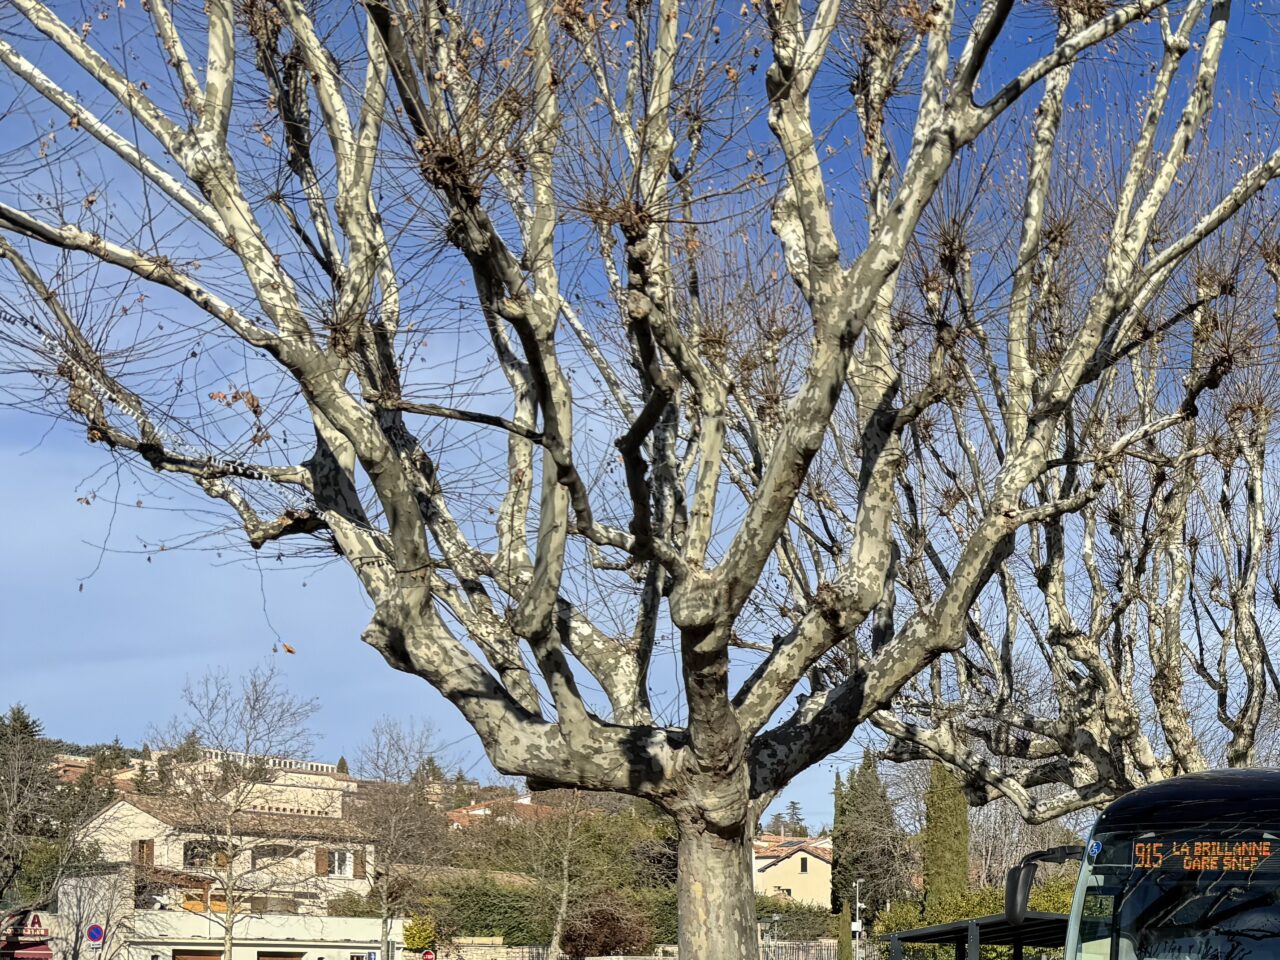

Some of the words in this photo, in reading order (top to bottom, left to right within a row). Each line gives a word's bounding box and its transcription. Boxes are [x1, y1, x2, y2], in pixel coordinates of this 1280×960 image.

[1135, 843, 1163, 868] 915
[1172, 841, 1190, 856] LA
[1194, 841, 1271, 856] BRILLANNE
[1183, 856, 1218, 870] GARE
[1223, 856, 1259, 870] SNCF
